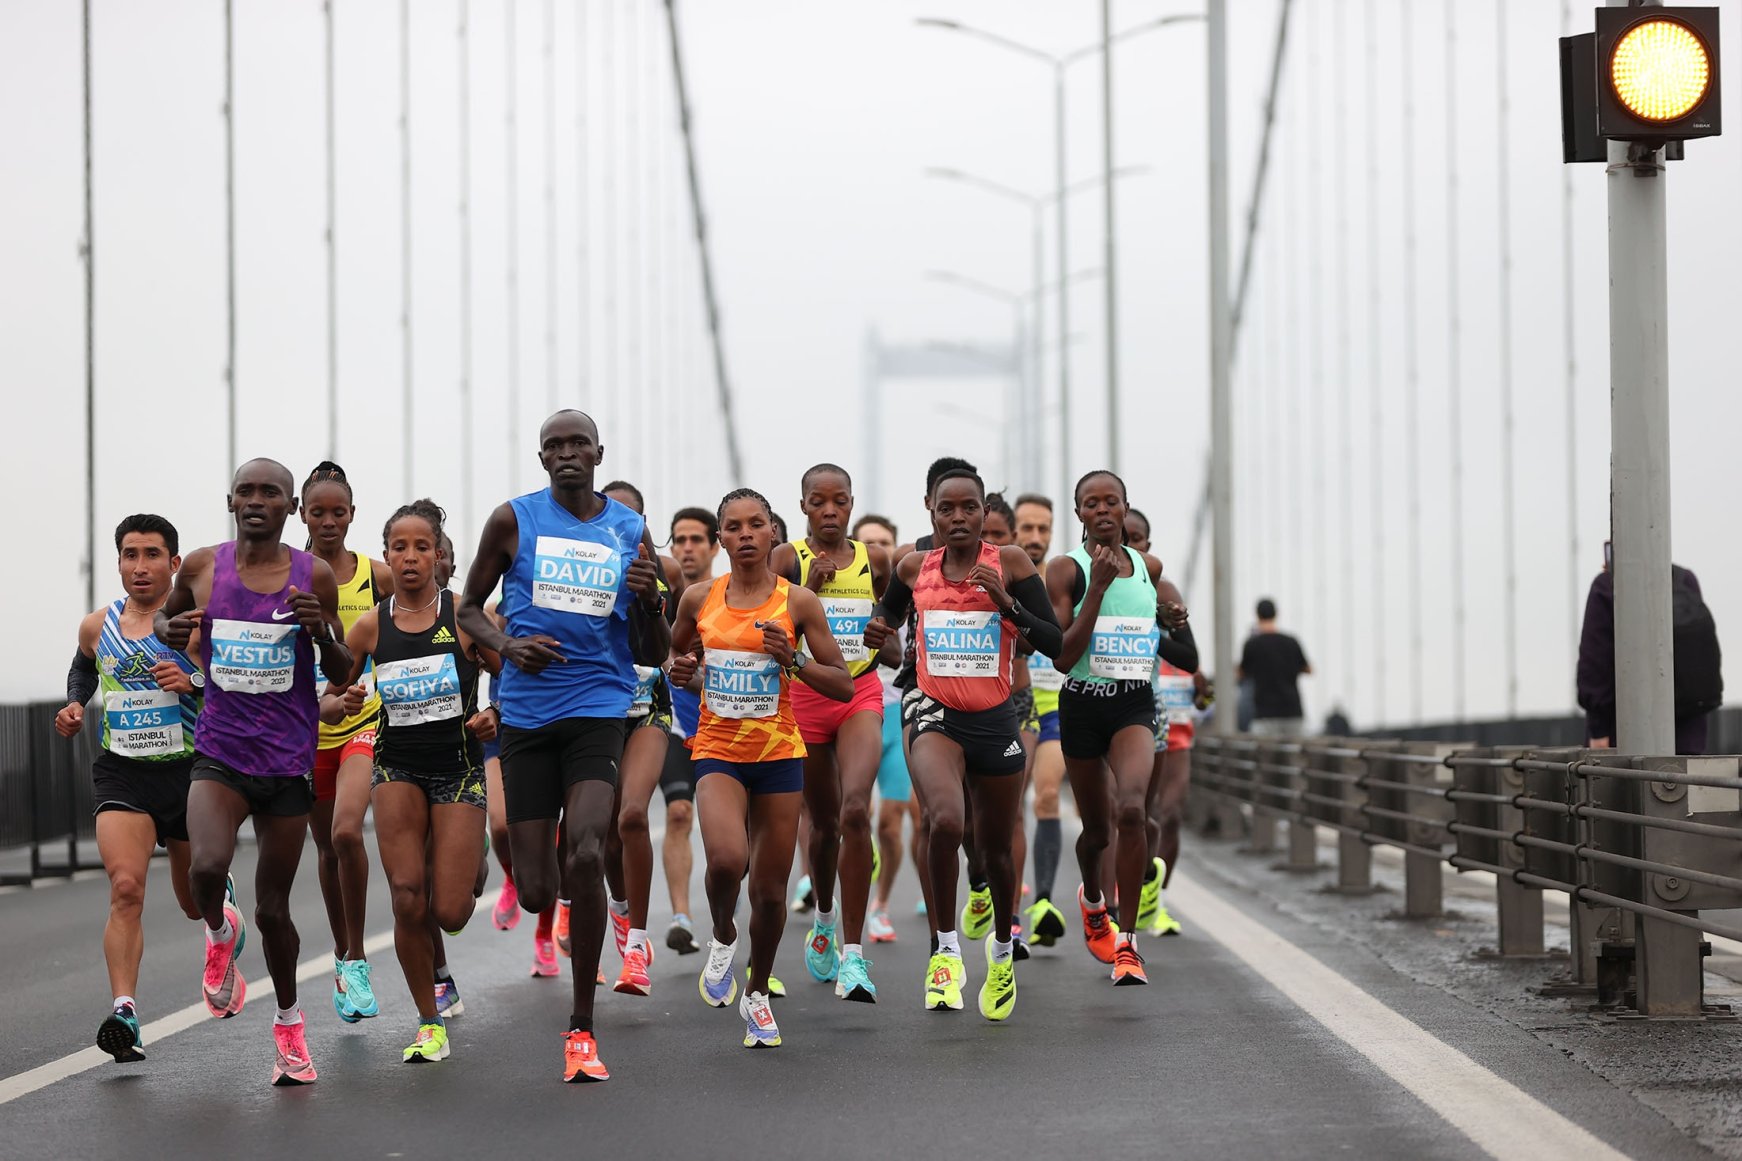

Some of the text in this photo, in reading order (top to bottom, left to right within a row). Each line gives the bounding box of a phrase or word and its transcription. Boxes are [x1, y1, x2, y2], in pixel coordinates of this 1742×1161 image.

[540, 559, 616, 587] DAVID
[538, 583, 571, 594] ISTANBUL
[572, 588, 612, 600] MARATHON
[592, 600, 606, 608] 2021
[835, 619, 859, 633] 491
[432, 636, 455, 644] adidas
[837, 639, 860, 647] ANBUL
[927, 632, 995, 649] SALINA
[1095, 636, 1158, 654] BENCY
[216, 644, 291, 664] VESTUS
[841, 647, 860, 655] ATHON
[1095, 656, 1122, 664] ISTANBUL
[216, 667, 290, 678] ISTANBUL MARATHON
[709, 669, 773, 692] EMILY
[383, 676, 454, 700] SOFIYA
[1081, 681, 1118, 697] PRO
[390, 696, 456, 710] ISTANBUL MARATHON
[708, 692, 734, 703] ISTANBUL
[438, 703, 453, 712] 2021
[120, 712, 162, 726] A 245
[128, 731, 166, 741] ISTANBUL
[129, 740, 168, 749] MARATHON
